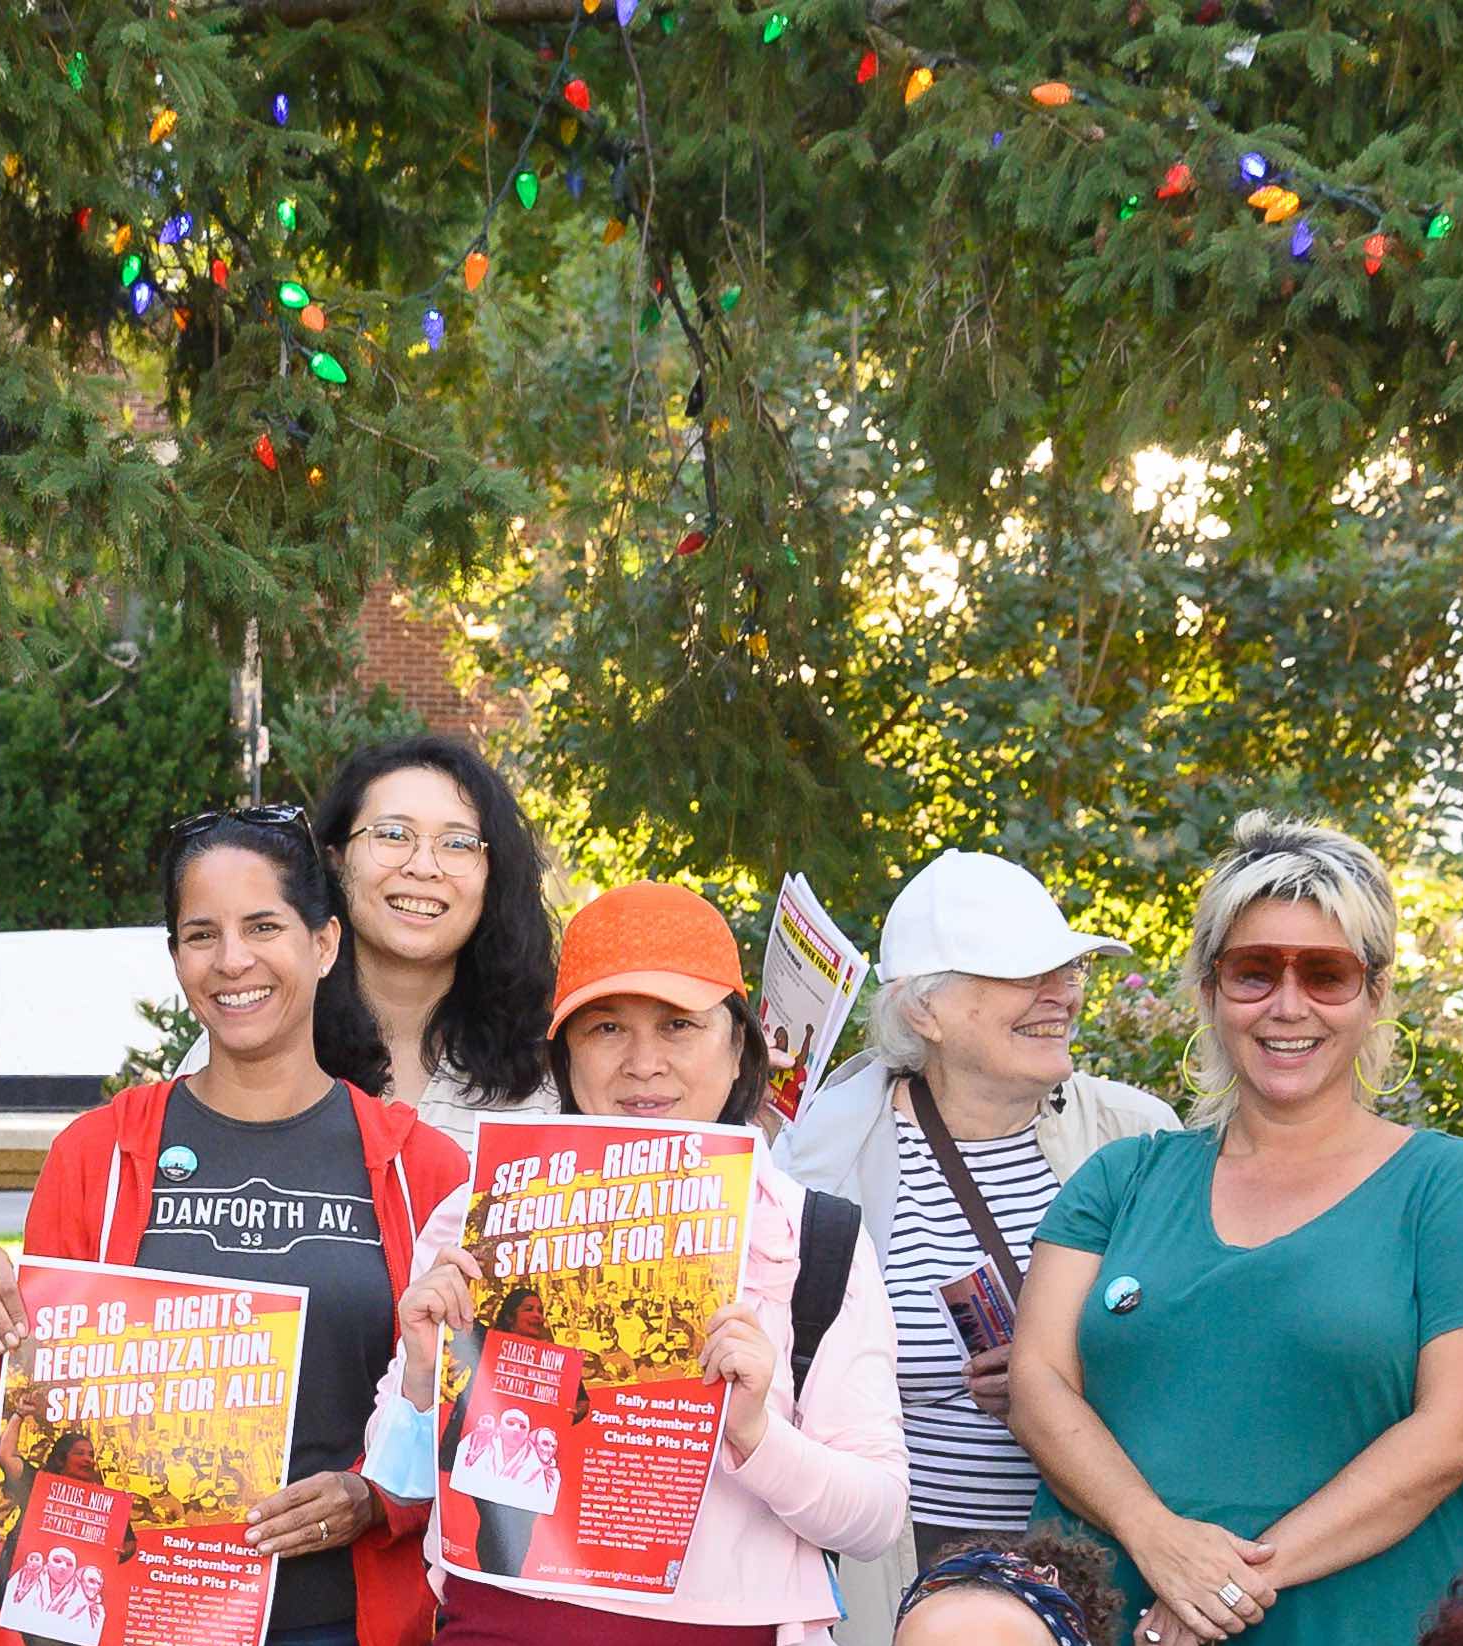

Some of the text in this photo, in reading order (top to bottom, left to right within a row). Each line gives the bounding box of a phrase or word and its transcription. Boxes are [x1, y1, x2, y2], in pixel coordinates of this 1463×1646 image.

[491, 1135, 710, 1197] SEP 18 RIGHTS.
[156, 1197, 359, 1232] DANFORTH AV.
[484, 1175, 728, 1238] REGULARIZATION.
[240, 1232, 263, 1246] 33
[494, 1217, 737, 1278] STATUS FOR ALL!
[34, 1291, 260, 1342] SEP 18 RIGHTS.
[32, 1331, 277, 1382] REGULARIZATION.
[500, 1340, 566, 1371] STATUS NOW
[45, 1371, 285, 1424] STATUS FOR ALL!
[615, 1393, 715, 1415] Rally and March
[591, 1410, 713, 1433] 2pm, September 18
[603, 1430, 709, 1452] Christie Pits Park
[49, 1482, 114, 1513] STATUS NOW
[163, 1536, 195, 1551] Rally
[197, 1540, 222, 1552] and
[138, 1551, 262, 1576] 2pm, September 18
[149, 1570, 260, 1593] Christie Pits Park
